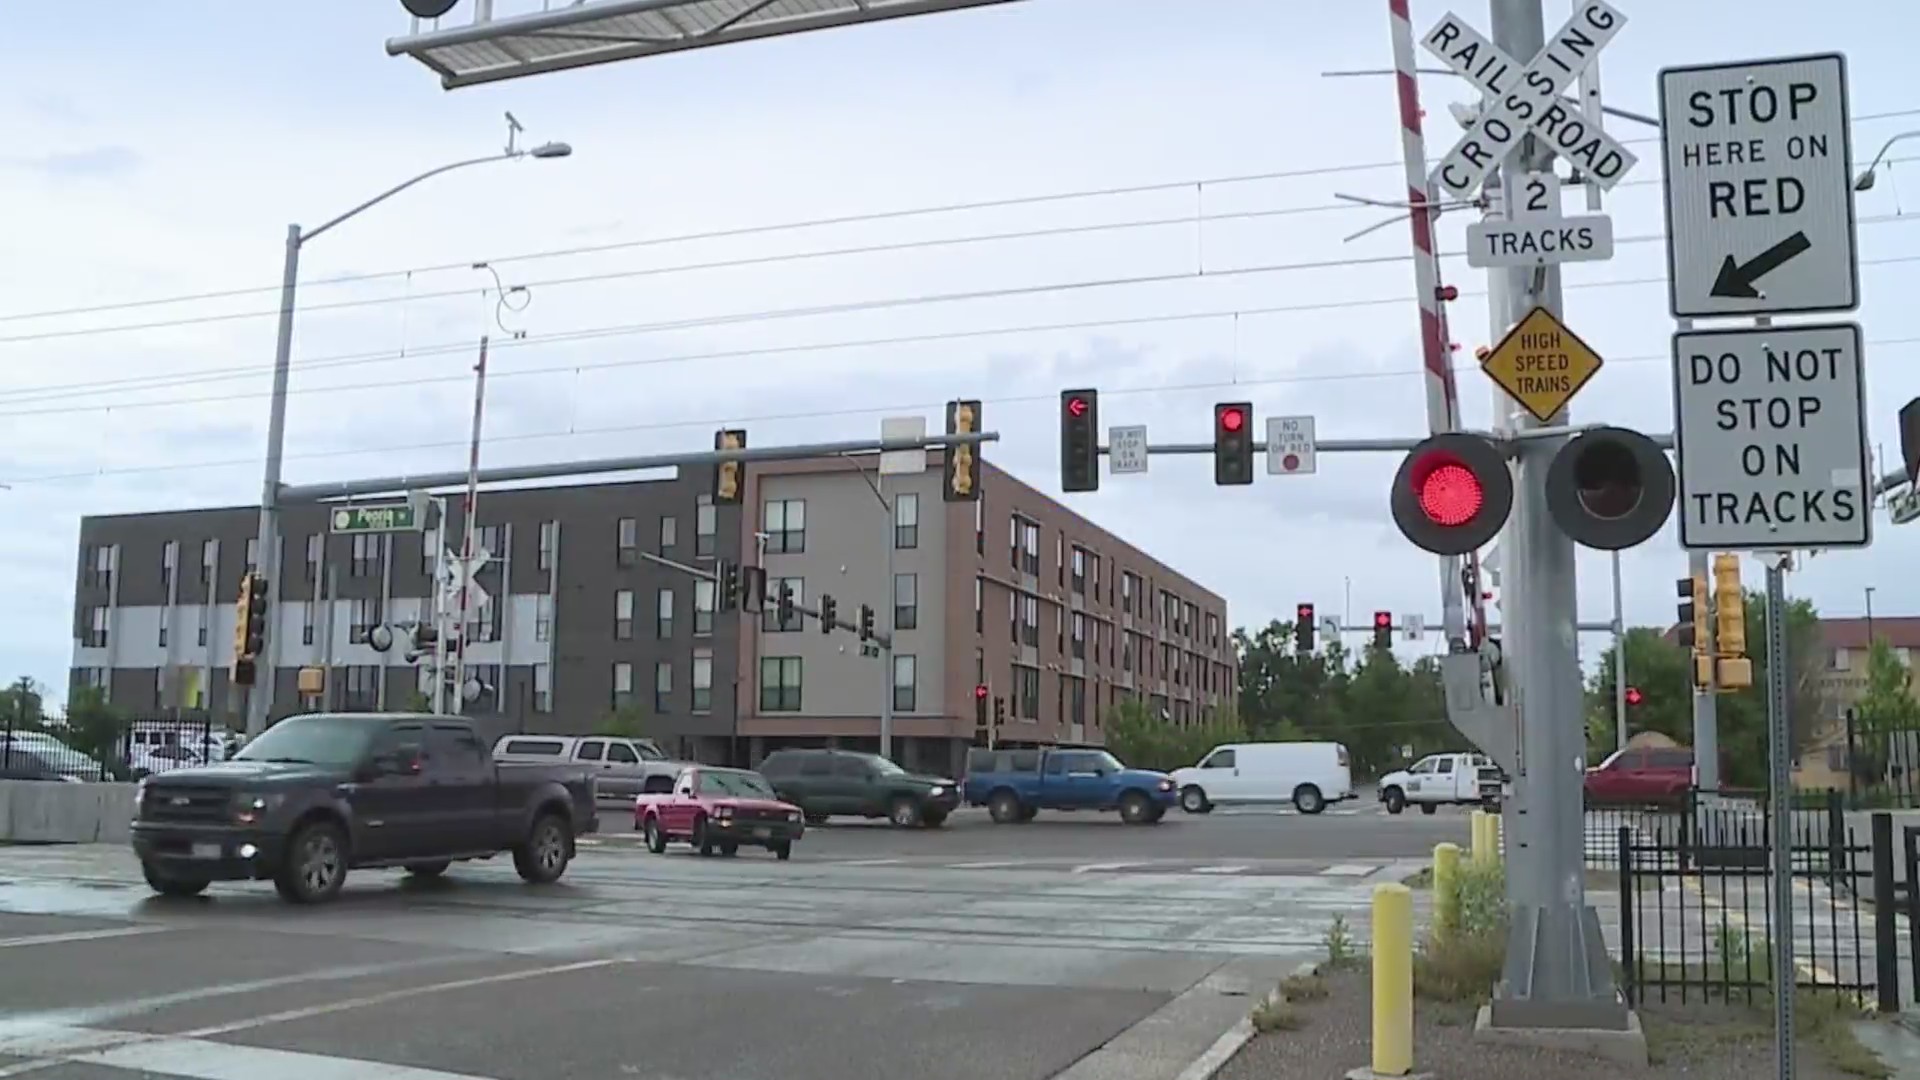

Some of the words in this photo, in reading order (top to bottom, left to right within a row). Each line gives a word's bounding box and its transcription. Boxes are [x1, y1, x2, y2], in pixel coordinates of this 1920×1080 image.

[1430, 21, 1508, 95] RAIL
[1535, 104, 1624, 178] ROAD
[1441, 5, 1615, 190] CROSSING
[1688, 82, 1818, 128] STOP
[1683, 139, 1766, 167] HERE
[1786, 134, 1828, 160] ON
[1525, 180, 1548, 211] 2
[1708, 176, 1805, 218] RED
[1486, 227, 1594, 255] TRACKS
[1520, 331, 1561, 350] HIGH
[1515, 355, 1569, 372] SPEED
[1690, 352, 1741, 385] DO
[1764, 347, 1842, 383] NOT
[1516, 376, 1571, 395] TRAINS
[1282, 420, 1298, 431] NO
[1716, 396, 1821, 430] STOP
[1278, 432, 1304, 442] TURN
[1741, 443, 1800, 476] ON
[1691, 489, 1855, 525] TRACKS
